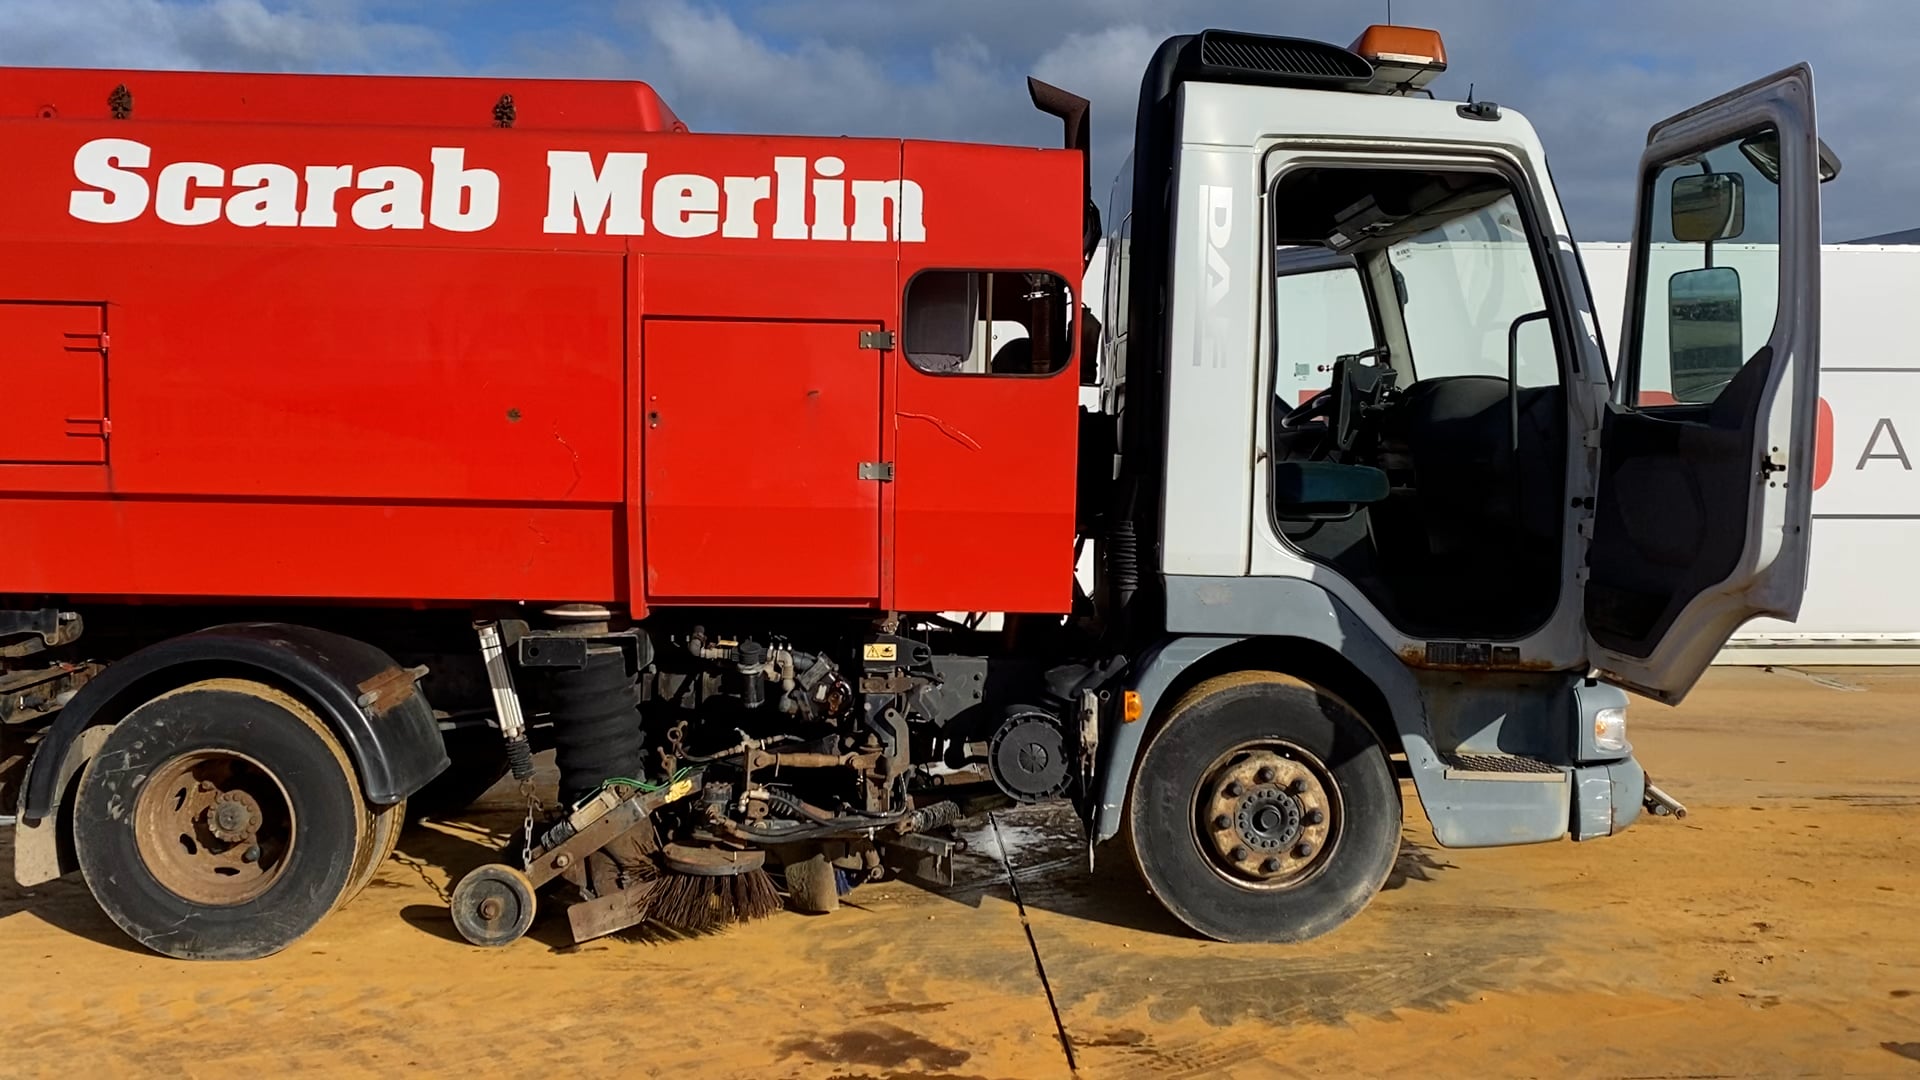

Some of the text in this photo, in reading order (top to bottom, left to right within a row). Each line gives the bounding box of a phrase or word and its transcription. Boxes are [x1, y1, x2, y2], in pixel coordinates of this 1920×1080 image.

[69, 139, 926, 243] Scarab Merlin
[1200, 185, 1232, 369] DAF
